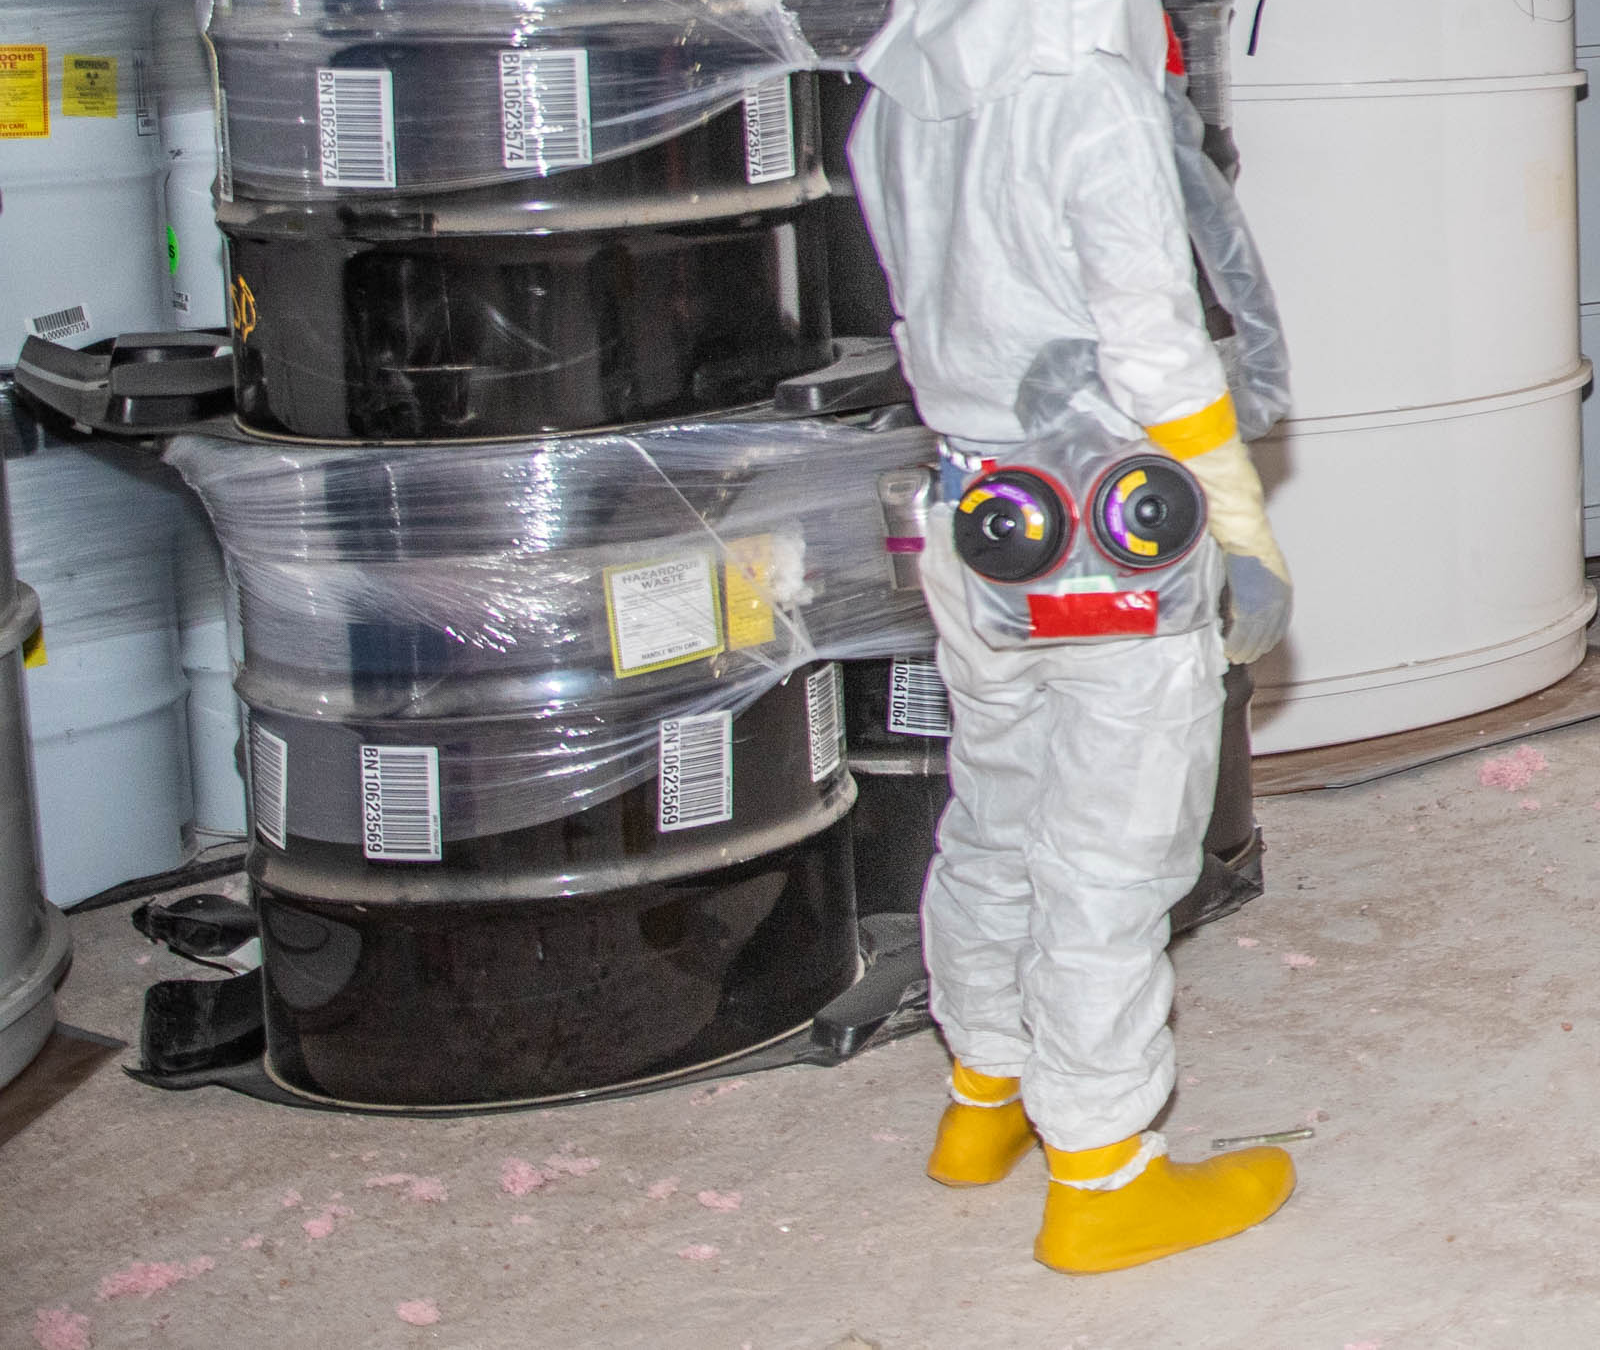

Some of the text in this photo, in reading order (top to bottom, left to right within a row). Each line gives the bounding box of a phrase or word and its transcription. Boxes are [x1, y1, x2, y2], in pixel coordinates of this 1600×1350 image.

[319, 71, 338, 182] BN10623574
[502, 52, 523, 163] BN10623574
[640, 572, 686, 590] WASTE
[363, 747, 383, 853] BN10623569
[661, 721, 680, 826] BN10623569
